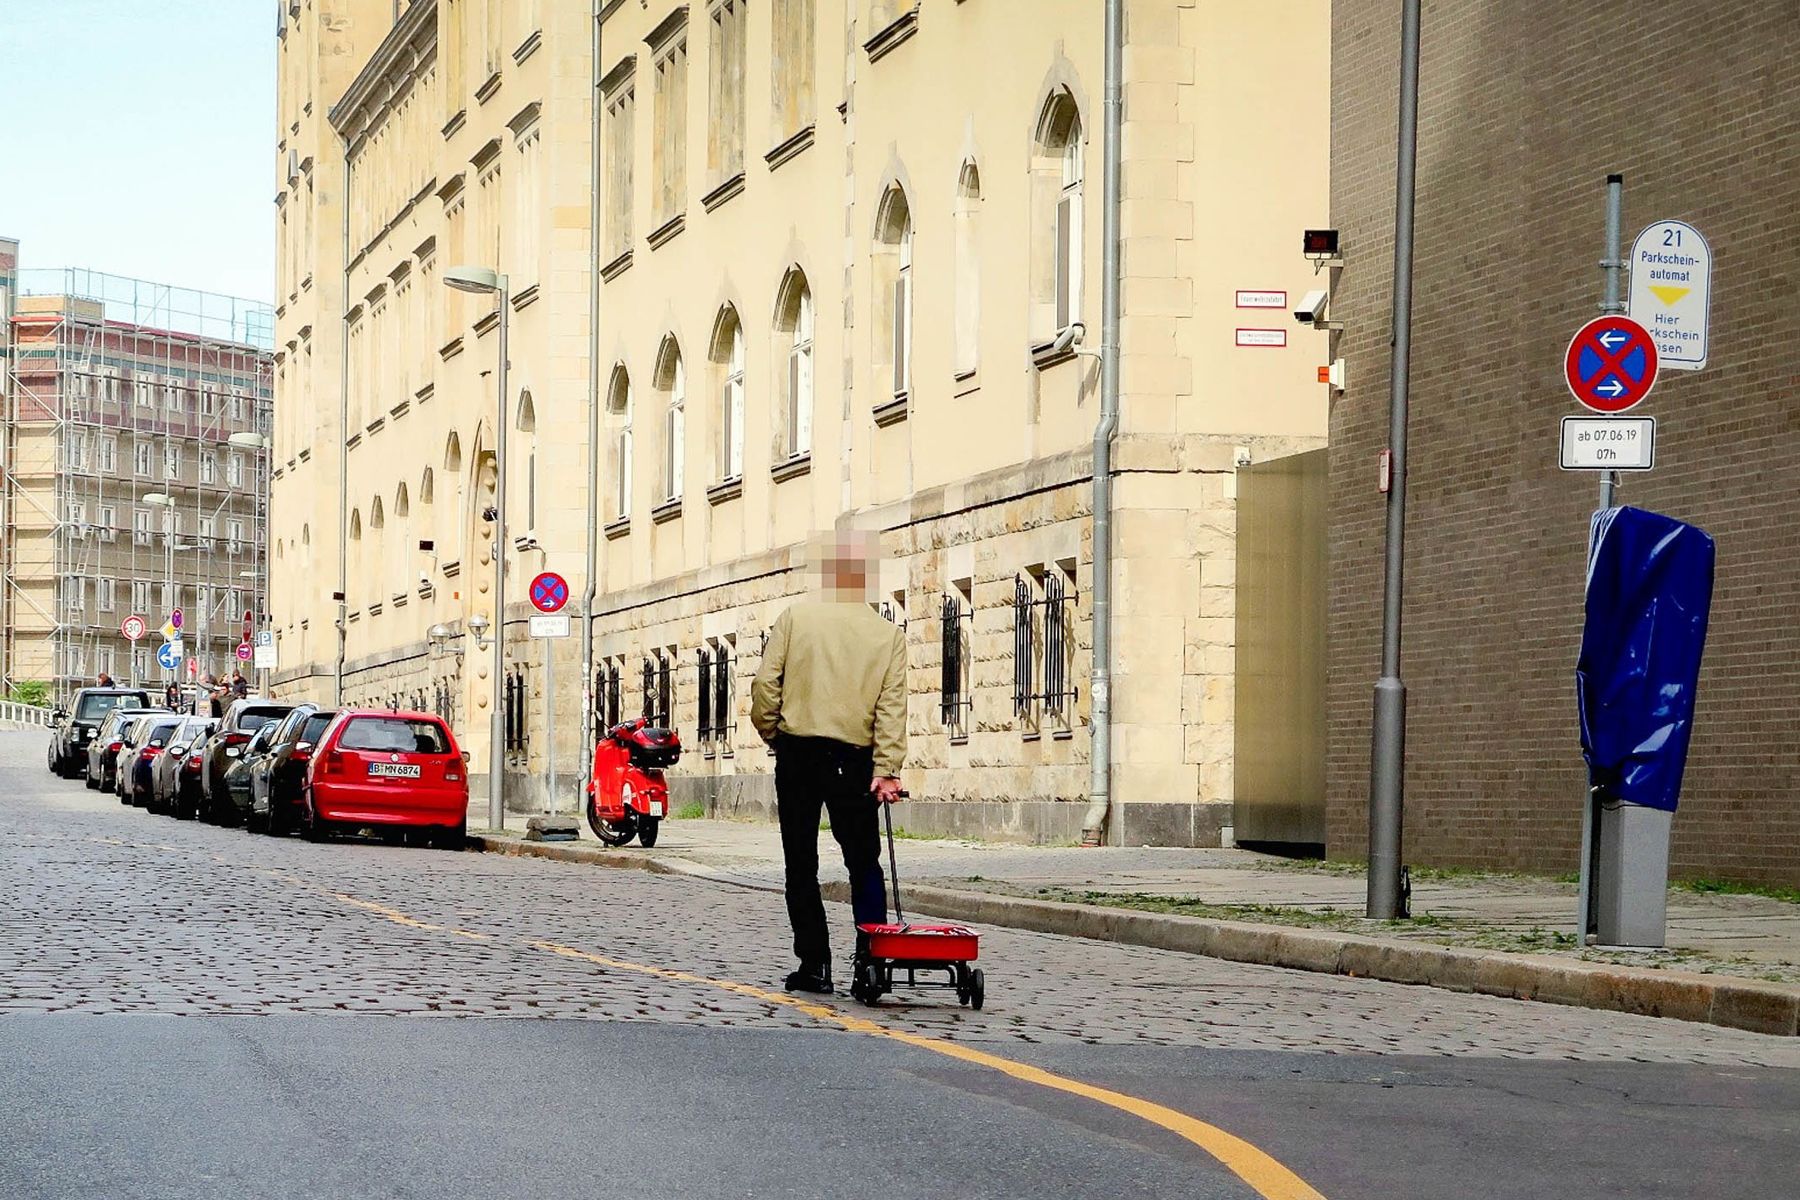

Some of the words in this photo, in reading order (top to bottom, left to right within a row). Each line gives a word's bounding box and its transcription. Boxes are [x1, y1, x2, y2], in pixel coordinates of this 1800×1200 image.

[1663, 228, 1681, 247] 21
[1641, 250, 1700, 266] Parkschein-
[1650, 269, 1690, 282] automat
[1655, 313, 1680, 325] Hier
[1649, 327, 1699, 341] kschein
[1577, 430, 1591, 441] ab
[1593, 429, 1637, 441] 07.06.19
[1596, 448, 1616, 460] 07h
[127, 622, 140, 634] 30
[261, 633, 270, 645] P
[397, 766, 419, 775] 6874
